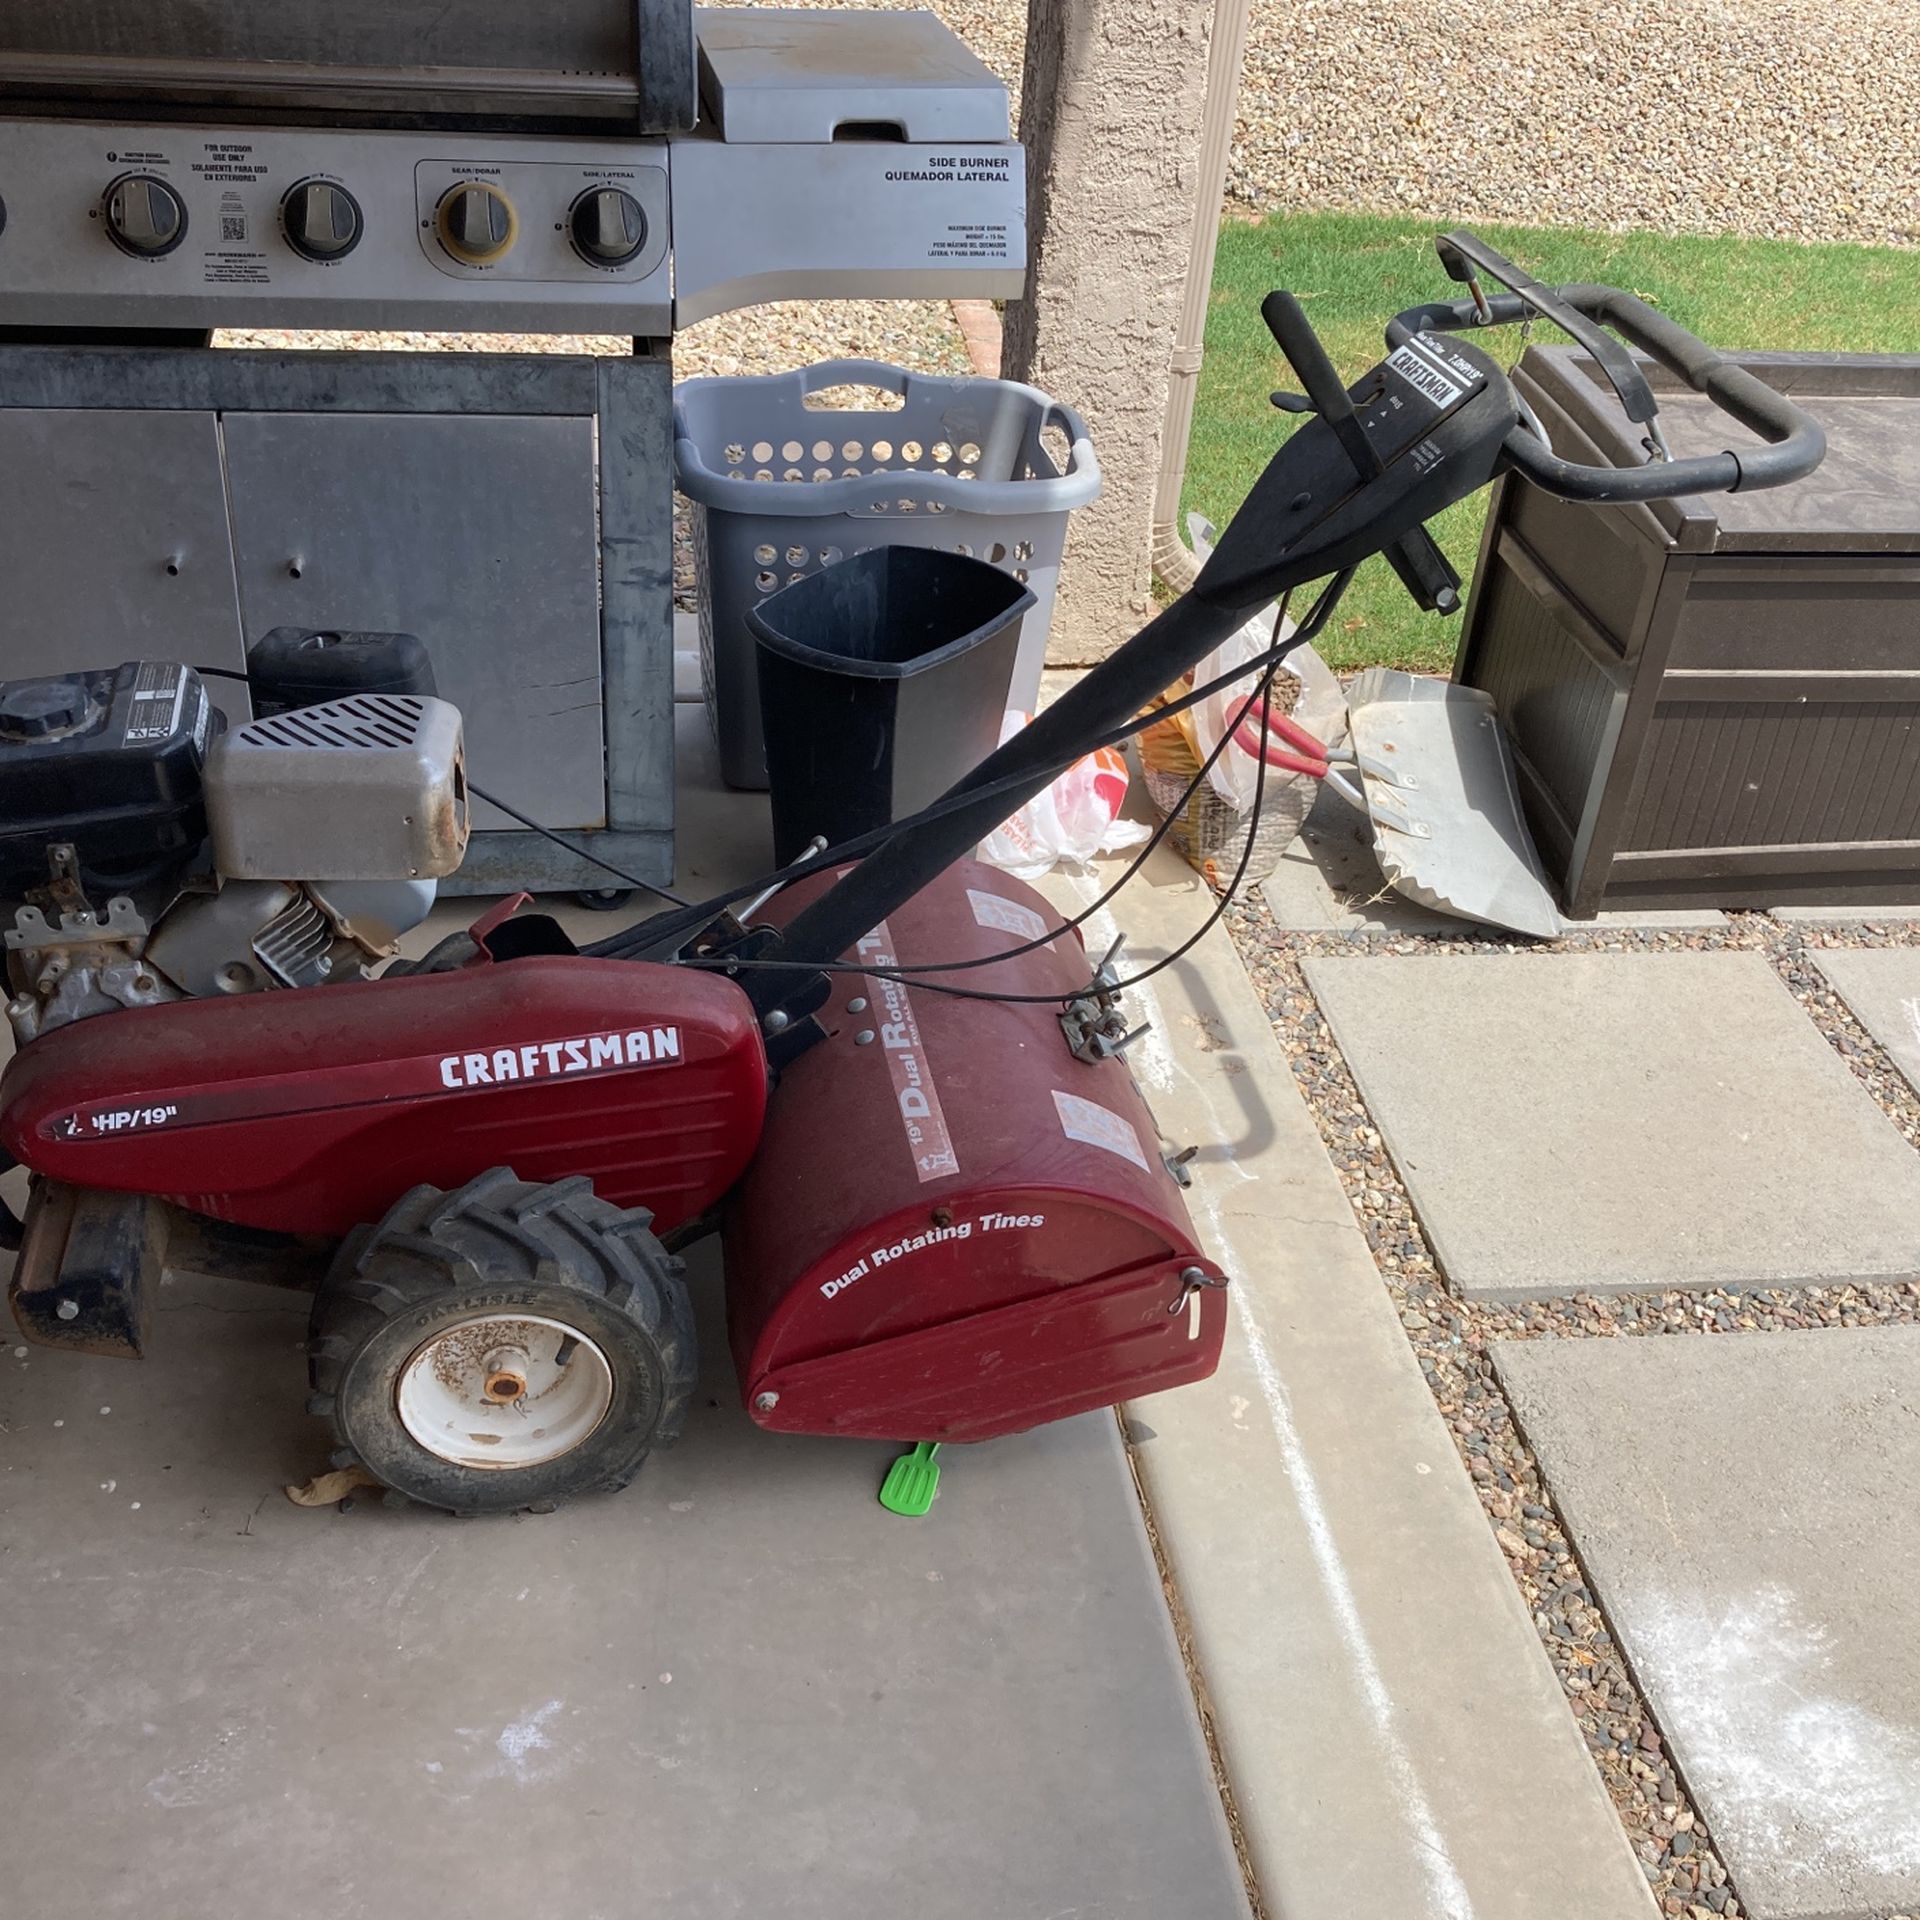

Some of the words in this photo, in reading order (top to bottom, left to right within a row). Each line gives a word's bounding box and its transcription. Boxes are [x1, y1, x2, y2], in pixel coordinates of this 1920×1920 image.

[204, 144, 219, 152] FOR
[220, 144, 253, 152] OUTDOOR
[212, 154, 226, 162] USE
[228, 154, 245, 162] ONLY
[929, 157, 956, 167] SIDE
[960, 158, 1009, 168] BURNER
[191, 164, 234, 173] SOLAMENTE
[234, 165, 254, 173] PARA
[215, 174, 257, 182] EXTERIORES
[582, 171, 635, 179] SIDE/LATERAL
[885, 171, 954, 181] QUEMADOR
[957, 172, 1009, 182] LATERAL
[1392, 352, 1454, 402] CRAFTSMAN
[440, 1027, 679, 1088] CRAFTSMAN
[898, 1054, 931, 1118] Dual
[819, 1259, 871, 1300] Dual
[871, 1221, 972, 1267] Rotating
[978, 1213, 1045, 1232] Tines
